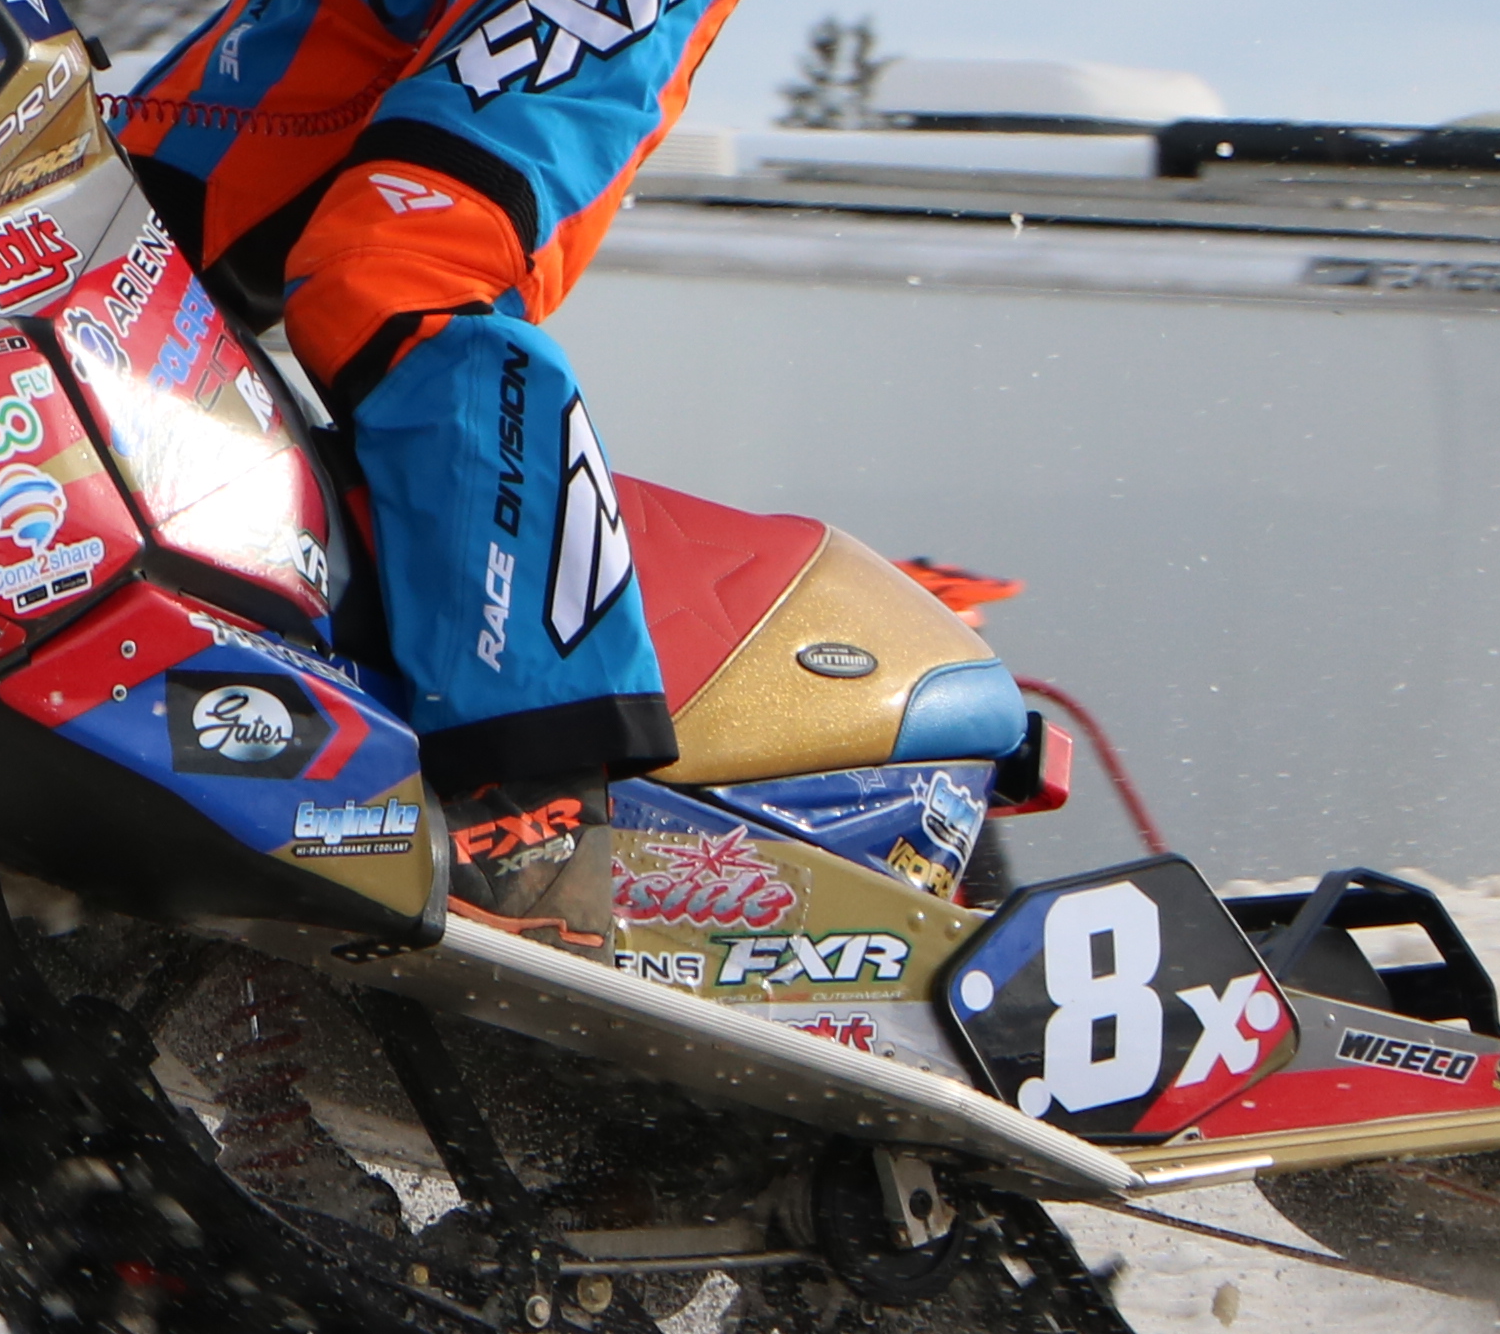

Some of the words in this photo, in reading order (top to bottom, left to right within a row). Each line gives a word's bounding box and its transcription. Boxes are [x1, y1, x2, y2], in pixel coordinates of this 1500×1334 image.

[18, 367, 52, 394] FLY
[493, 340, 530, 539] DIVISION
[476, 540, 515, 675] RACE
[195, 693, 294, 751] Gates
[293, 799, 382, 846] Engine
[295, 842, 372, 857] HI-PERFORMANCE
[372, 841, 410, 854] COOLANT
[450, 797, 583, 865] FXR
[710, 931, 911, 985] FXR
[1337, 1028, 1478, 1083] WISECO
